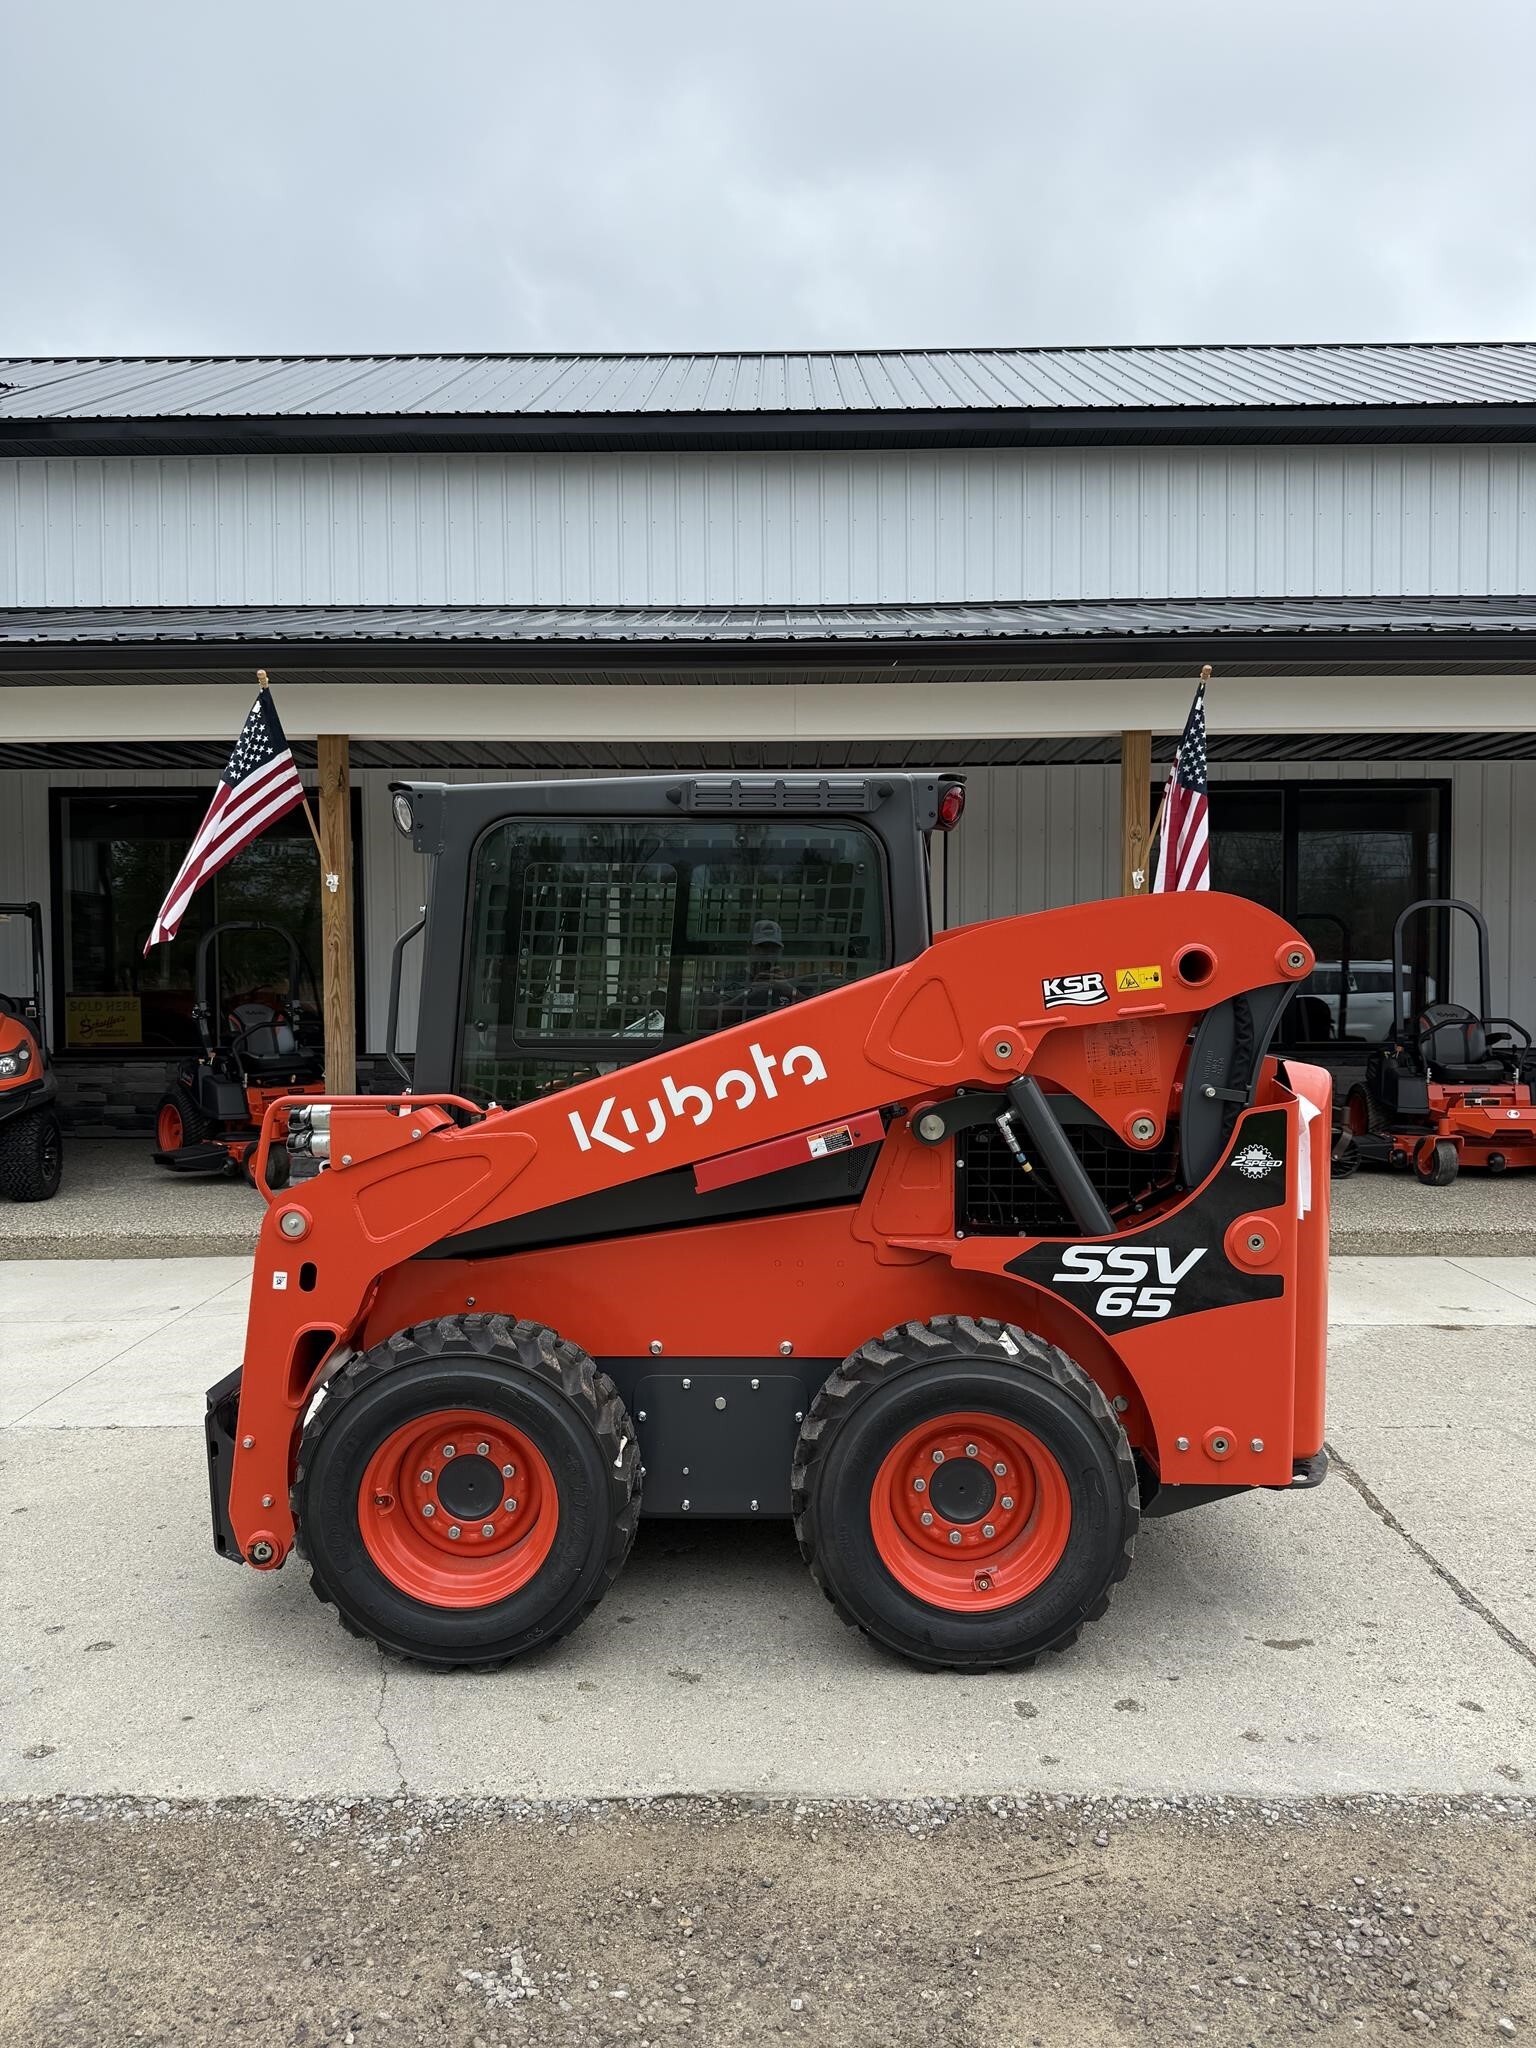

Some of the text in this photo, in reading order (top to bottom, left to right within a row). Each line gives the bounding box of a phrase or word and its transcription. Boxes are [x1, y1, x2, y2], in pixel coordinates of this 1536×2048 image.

[1043, 973, 1103, 996] KSR
[69, 1000, 137, 1012] SOLD HERE
[569, 1043, 828, 1154] Kubota
[1053, 1245, 1208, 1284] SSV
[1095, 1287, 1177, 1318] 65
